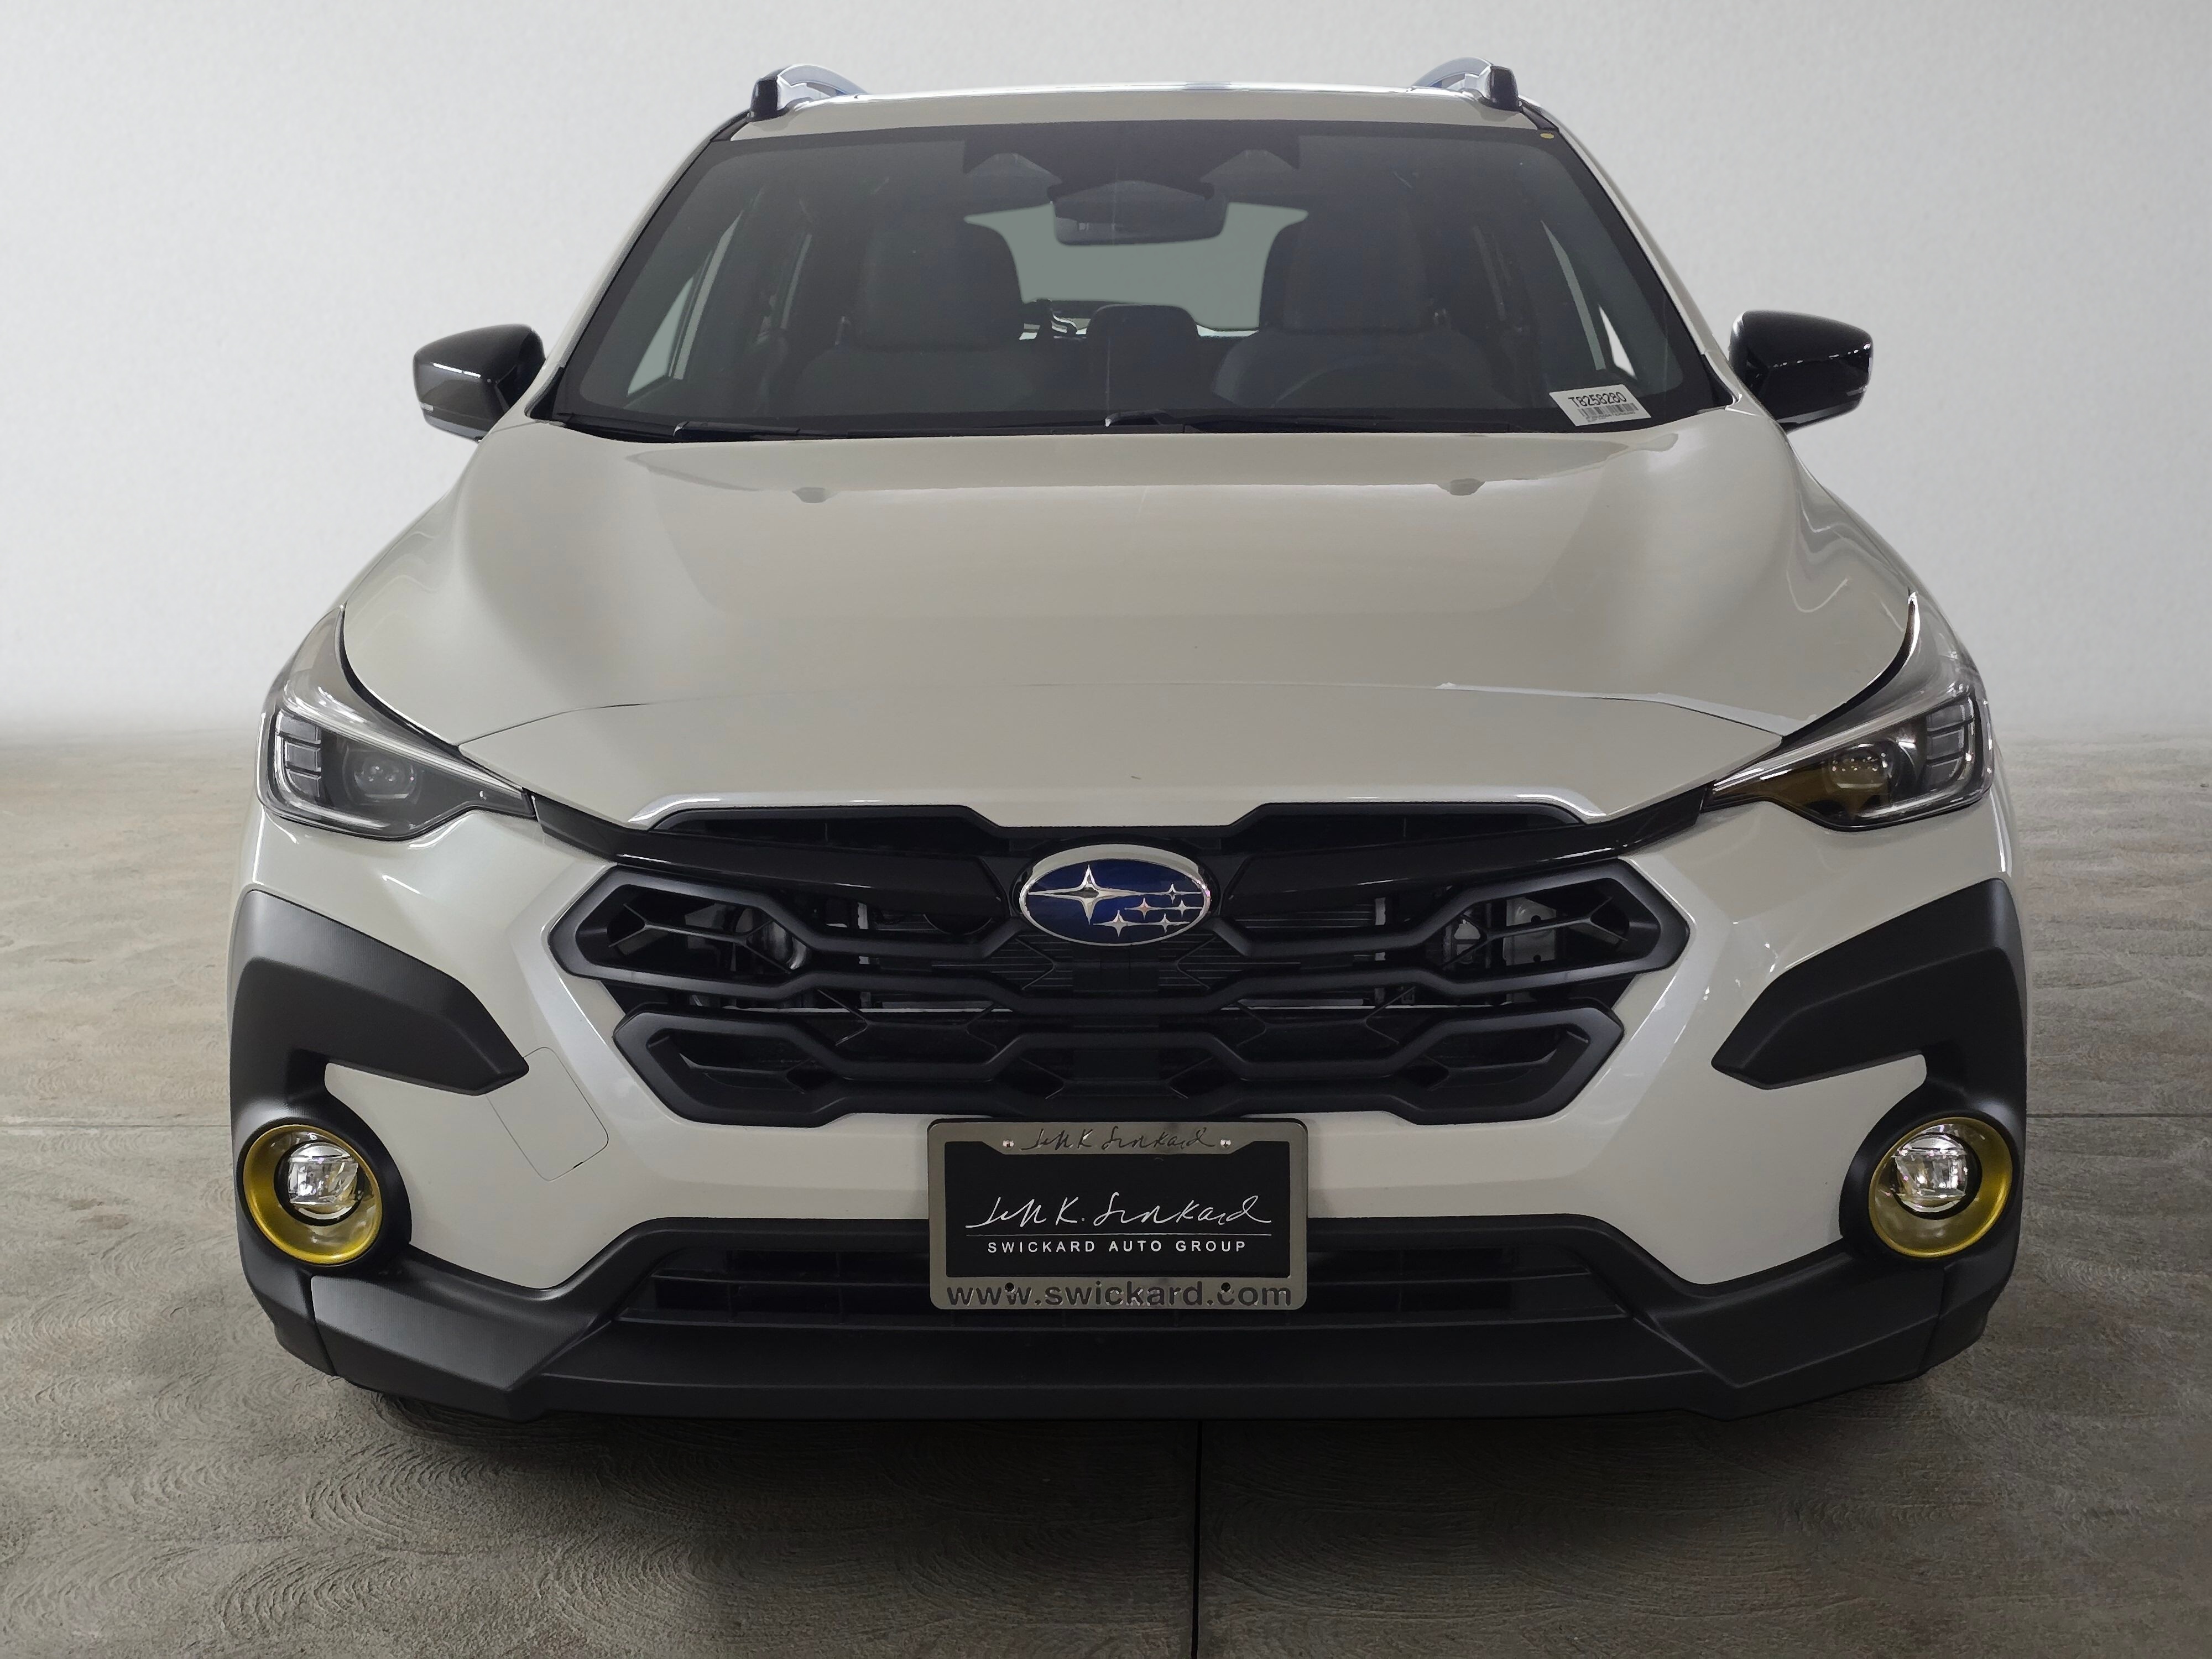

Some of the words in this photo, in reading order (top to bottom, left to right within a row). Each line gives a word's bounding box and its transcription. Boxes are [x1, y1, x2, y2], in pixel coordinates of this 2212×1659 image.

[1568, 392, 1627, 408] T8258280
[1055, 1197, 1085, 1226] K.
[988, 1240, 1095, 1253] SWICKARD
[1108, 1240, 1162, 1252] AUTO
[1175, 1240, 1245, 1252] GROUP
[947, 1281, 1291, 1307] www.swickard.com
